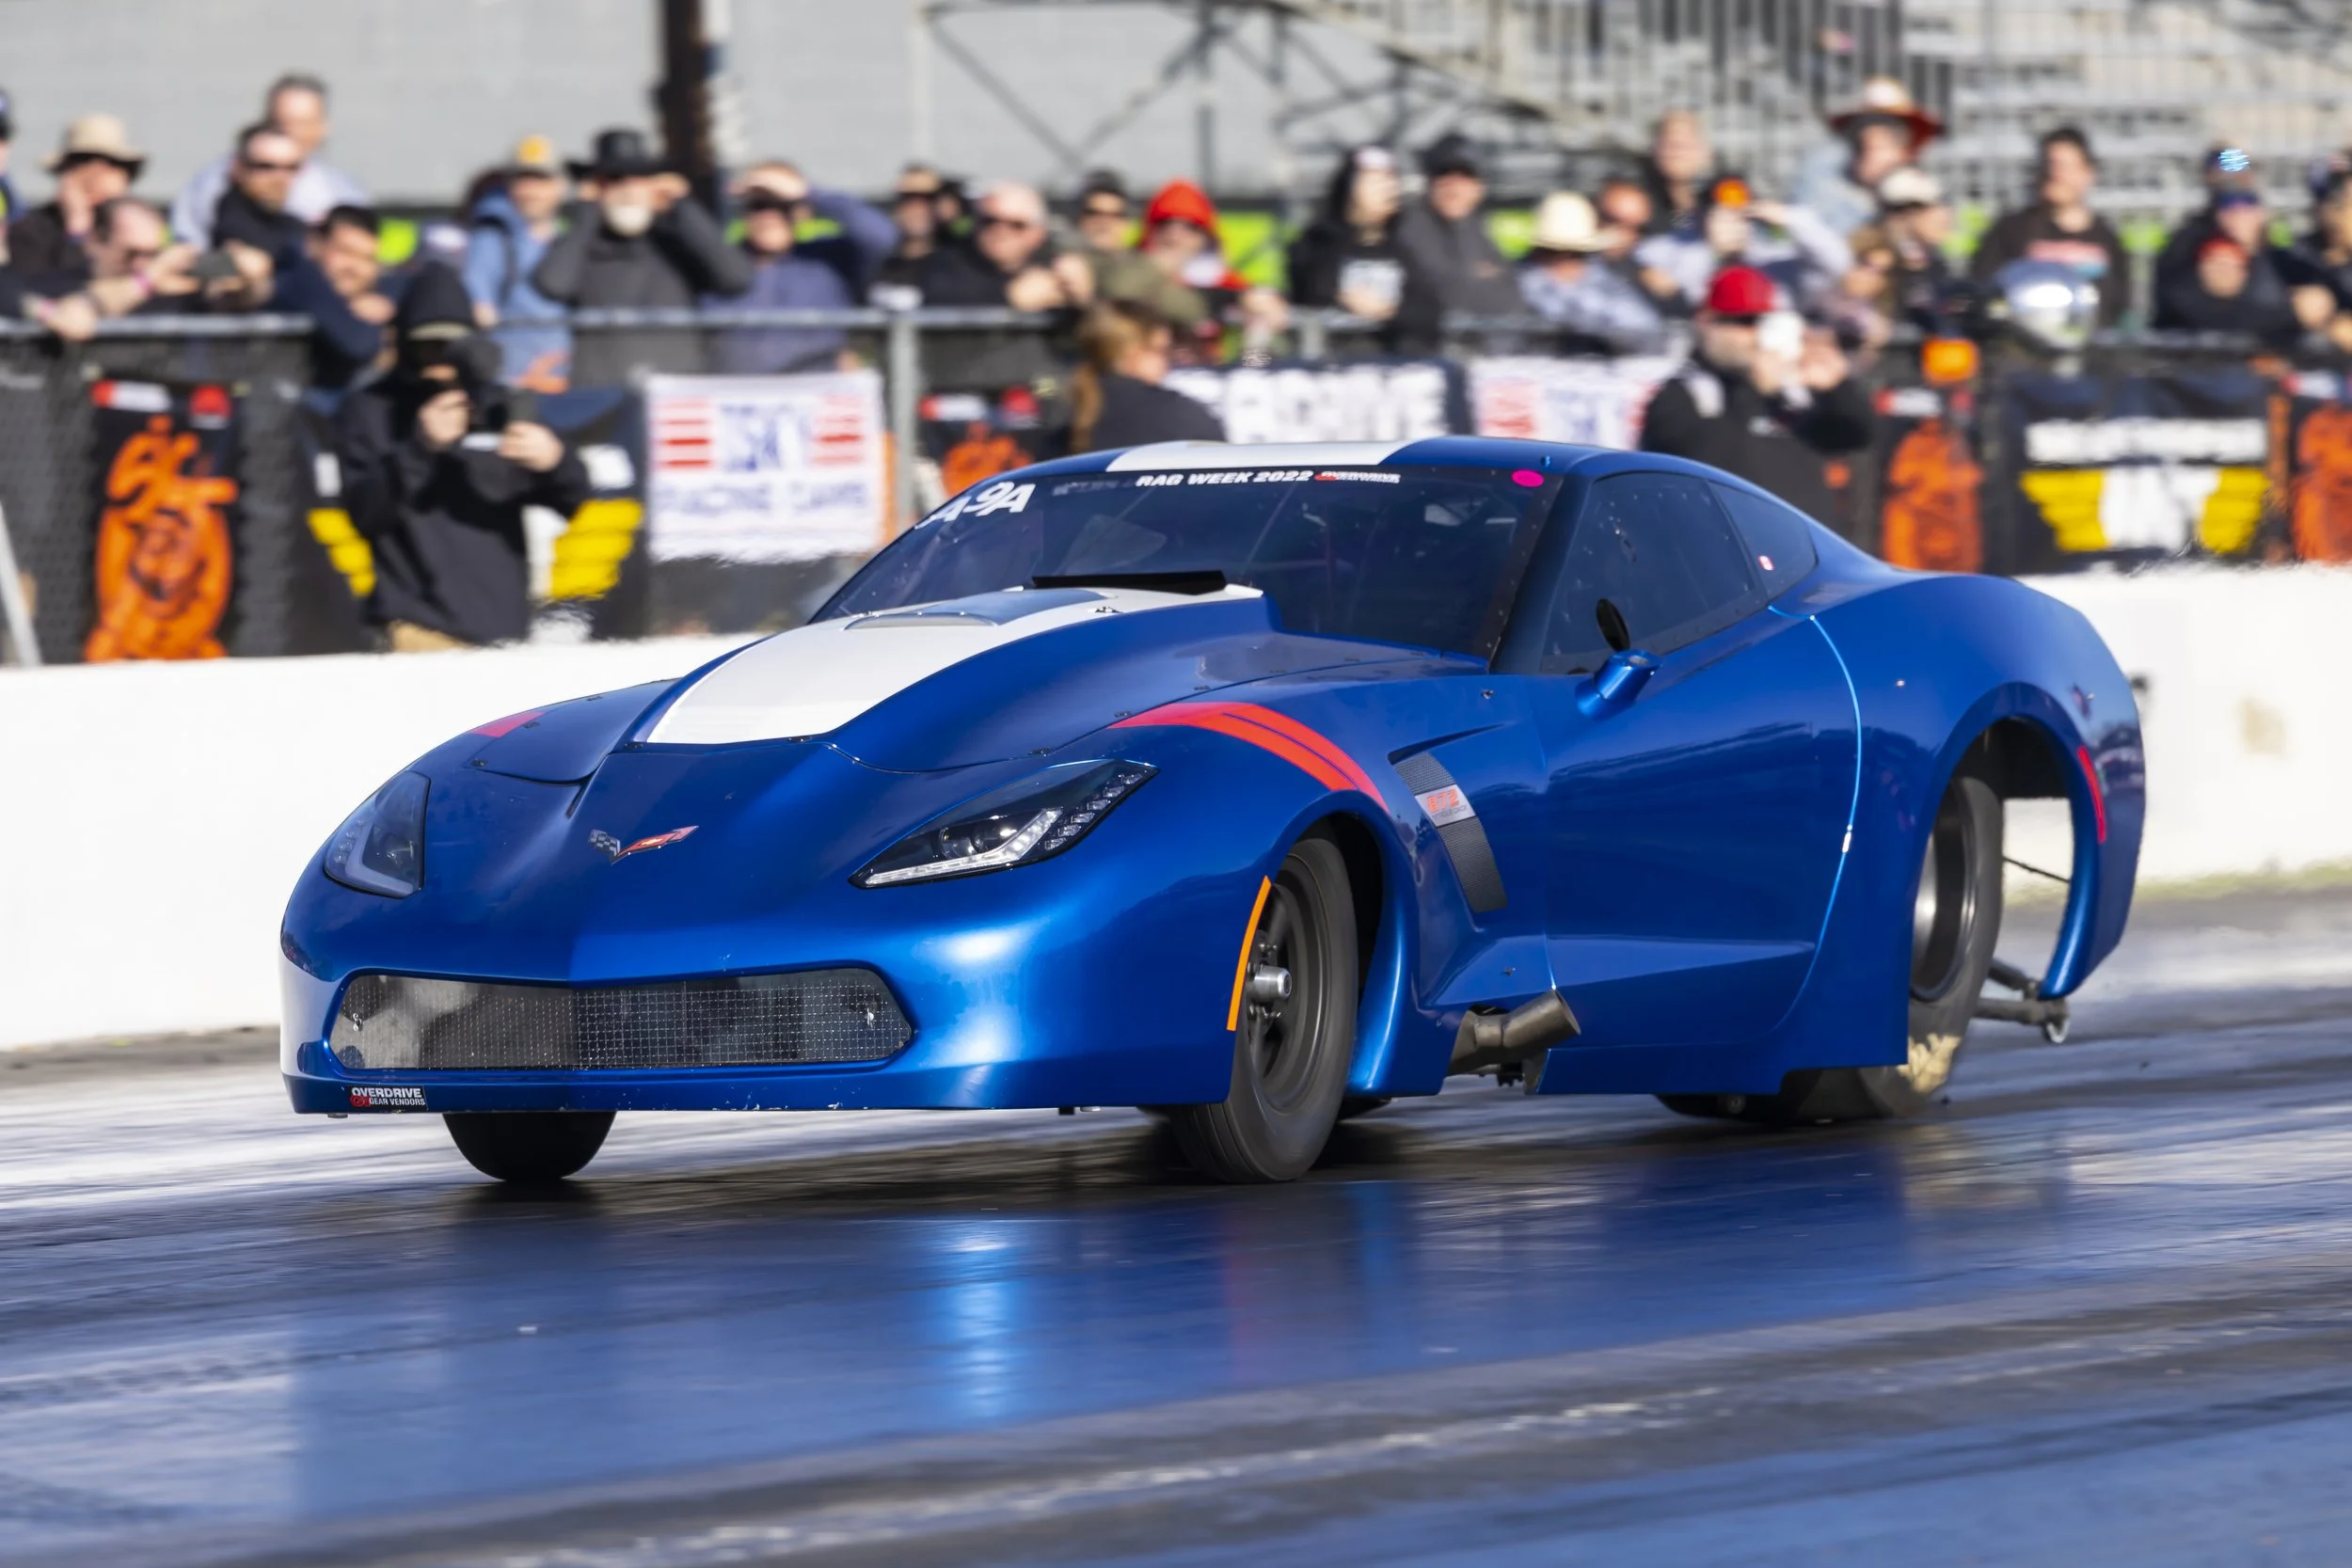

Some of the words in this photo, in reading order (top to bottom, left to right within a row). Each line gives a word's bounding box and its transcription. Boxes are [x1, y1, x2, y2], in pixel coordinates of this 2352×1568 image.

[1136, 474, 1184, 486] RAG
[1187, 471, 1254, 485] WEEK
[1252, 470, 1314, 483] 2022
[351, 1087, 422, 1099] OVERDRIVE
[369, 1097, 389, 1105] GEAR
[389, 1098, 426, 1106] VENDORS
